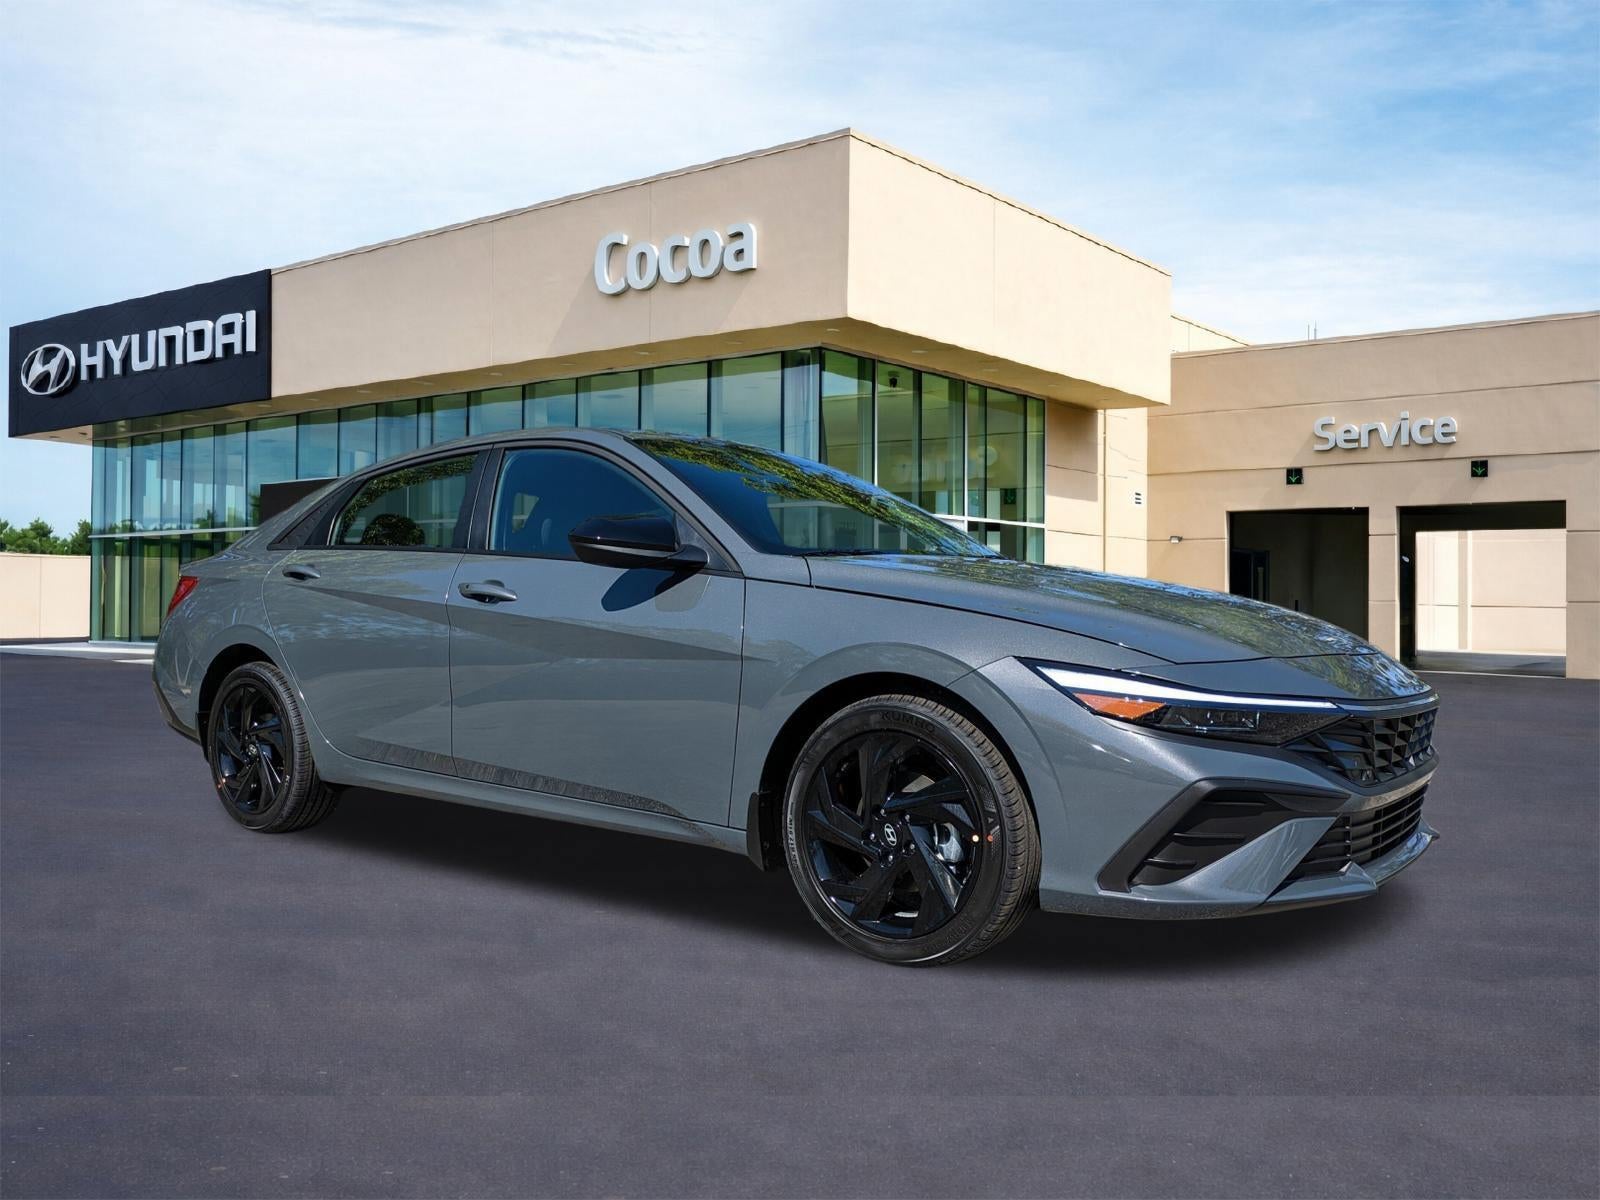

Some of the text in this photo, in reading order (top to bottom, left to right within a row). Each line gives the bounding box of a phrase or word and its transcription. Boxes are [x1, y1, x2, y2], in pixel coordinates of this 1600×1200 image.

[594, 223, 758, 296] Cocoa
[80, 310, 257, 382] HYUNDAI
[1313, 411, 1459, 451] Service
